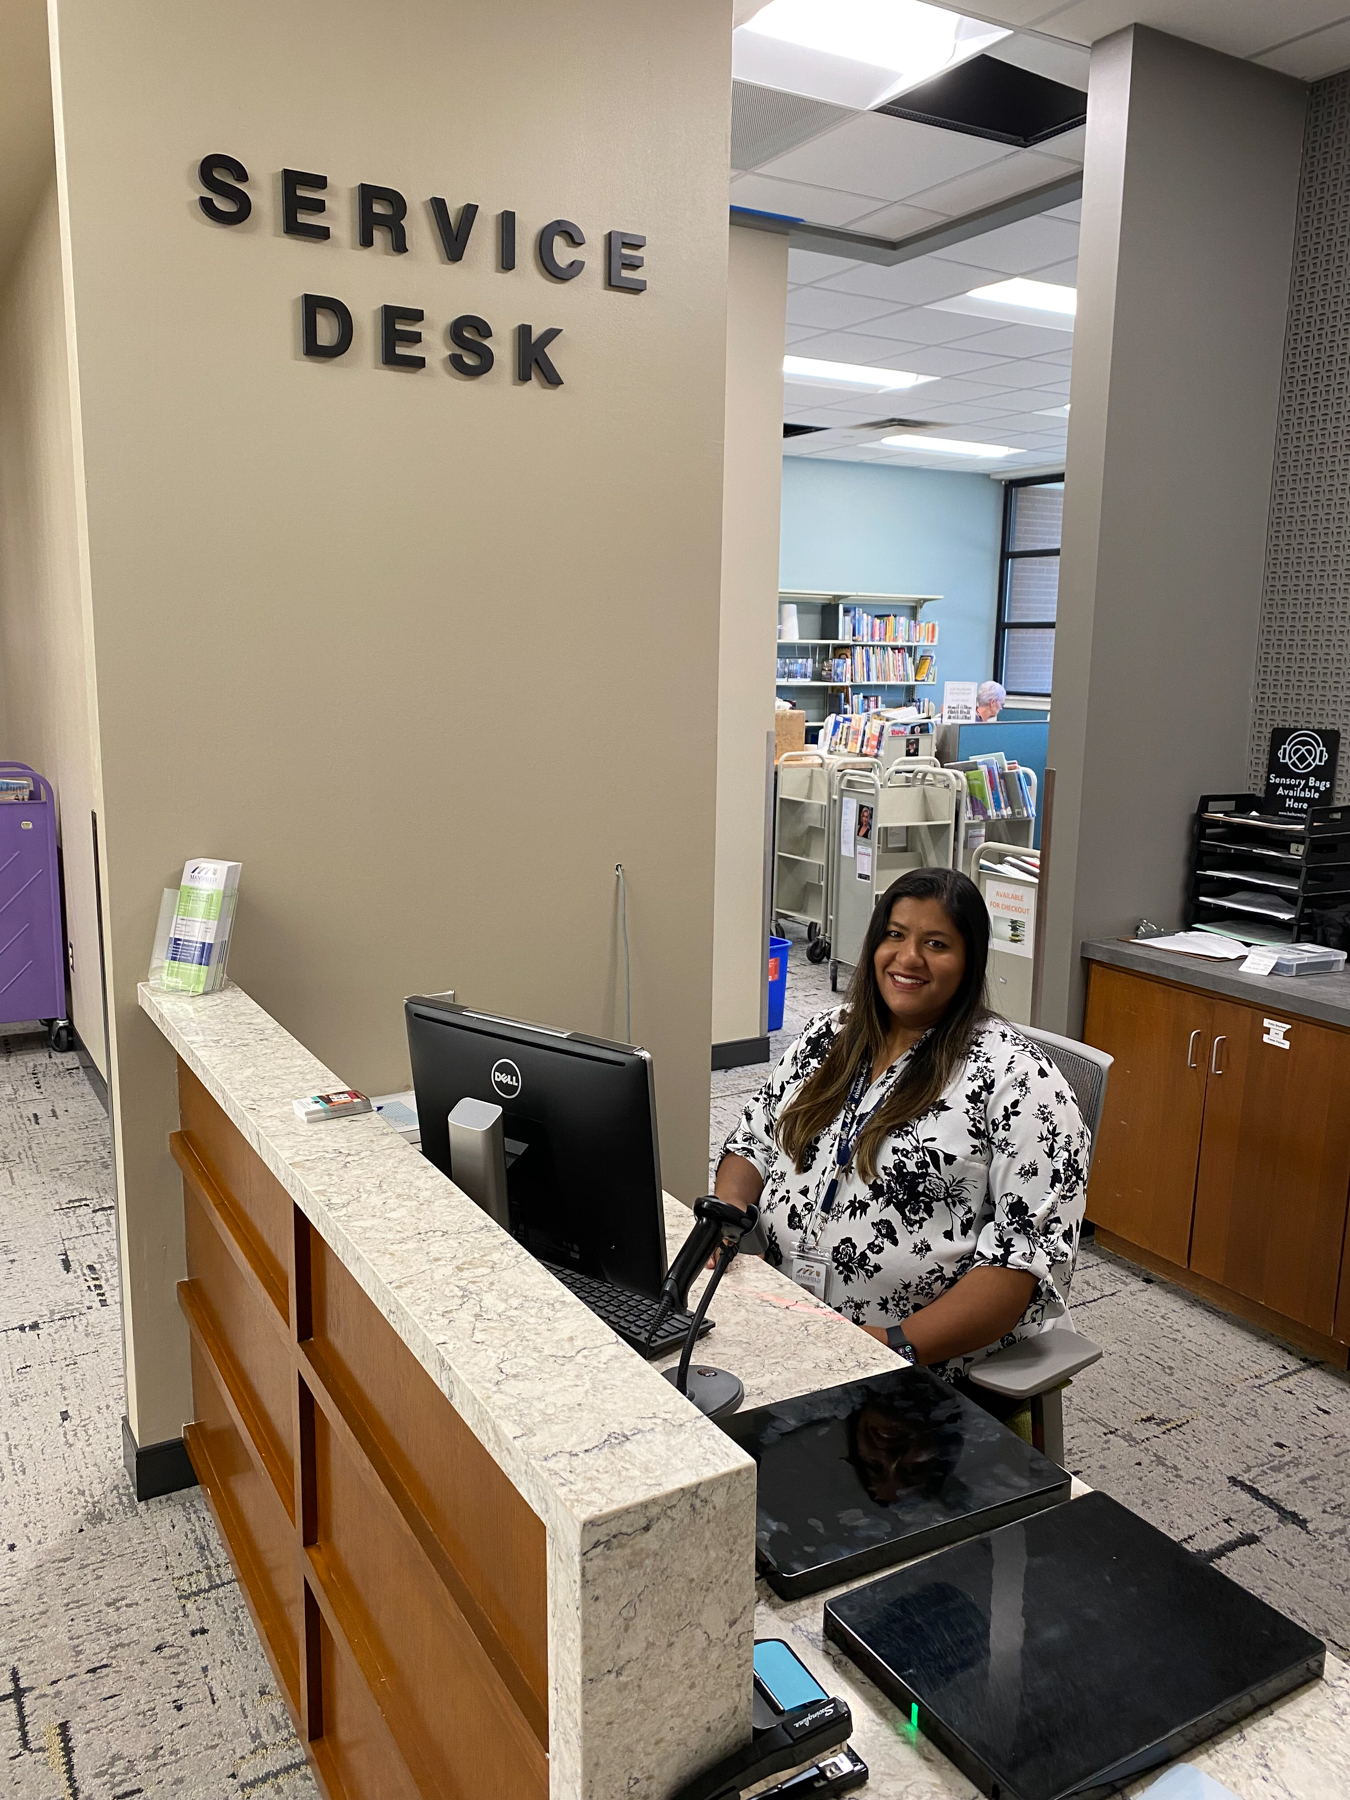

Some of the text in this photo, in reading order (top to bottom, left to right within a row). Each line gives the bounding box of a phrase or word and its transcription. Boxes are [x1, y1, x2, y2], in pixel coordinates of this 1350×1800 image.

[197, 153, 647, 293] SERVICE
[302, 293, 564, 385] DESK
[1269, 774, 1331, 791] Sensory Bags
[1276, 786, 1320, 799] Available
[1285, 798, 1309, 809] Here
[995, 890, 1024, 902] AVAILABLE
[990, 901, 1030, 915] FOR CHECKOUT
[494, 1071, 519, 1087] DELL
[793, 1703, 836, 1728] Swingline
